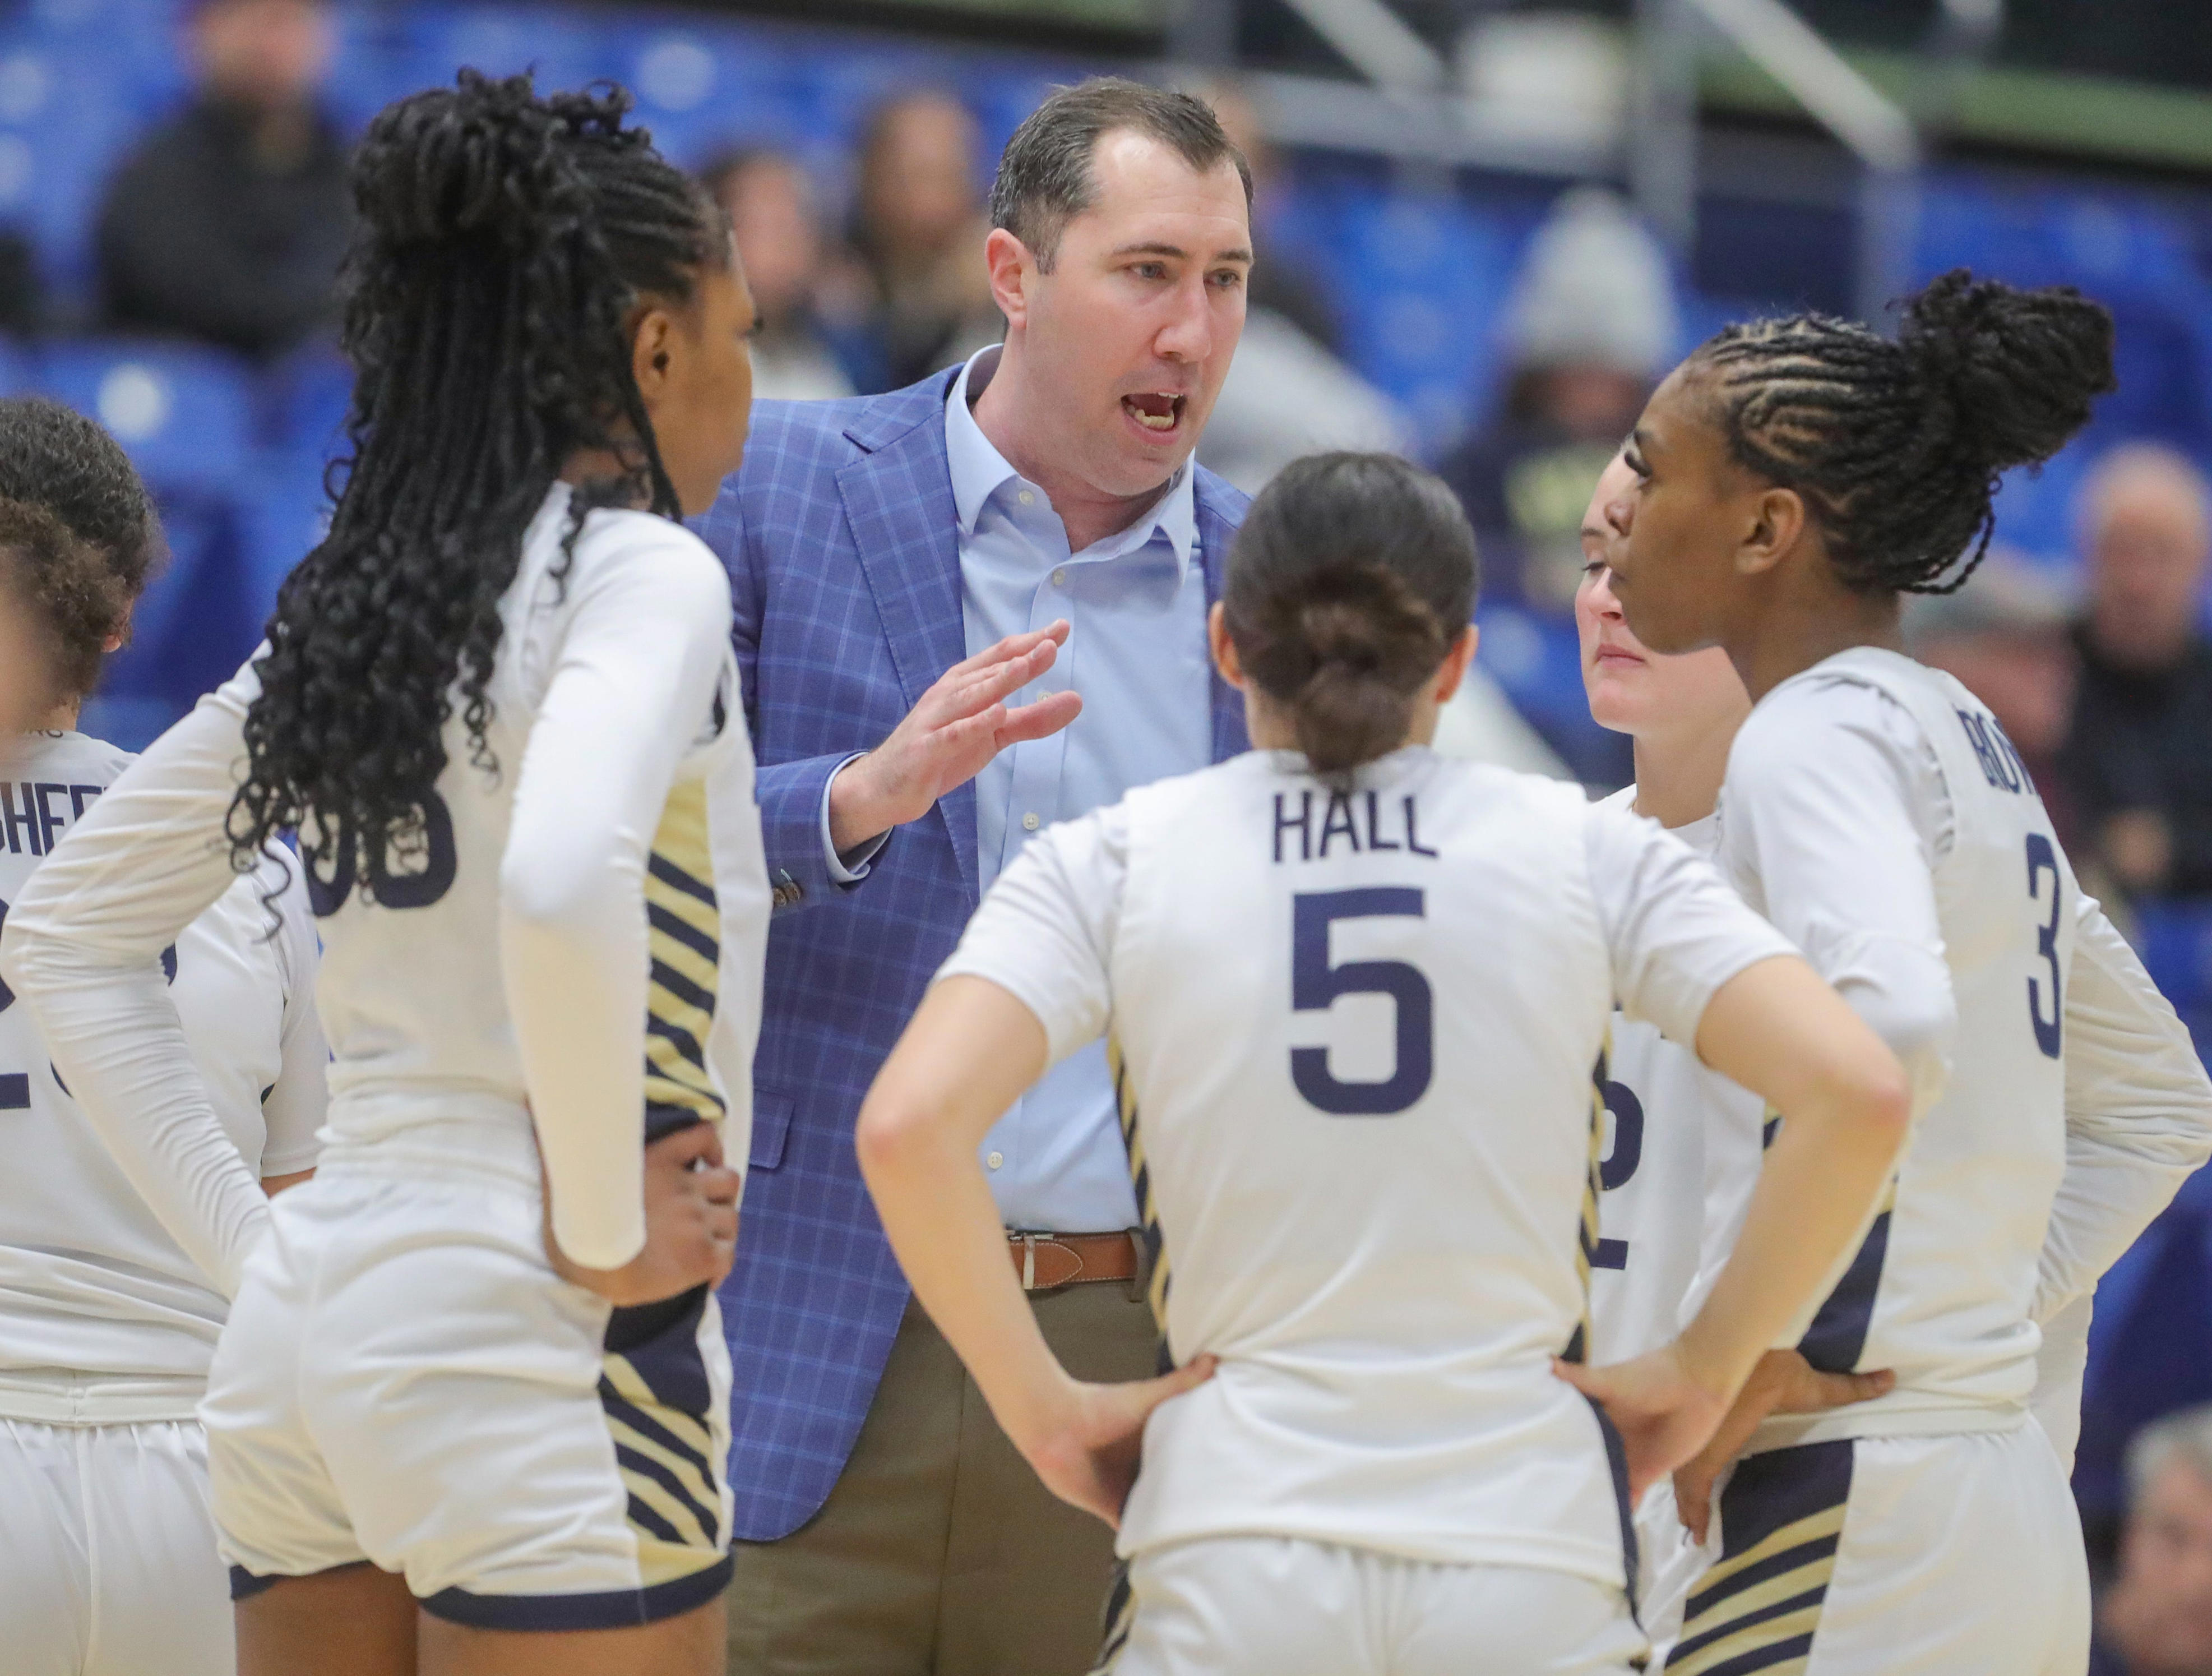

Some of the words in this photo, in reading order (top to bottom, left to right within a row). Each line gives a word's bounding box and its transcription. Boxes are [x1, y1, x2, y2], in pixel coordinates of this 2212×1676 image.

[1274, 791, 1438, 862] HALL
[1292, 887, 1432, 1115] 5
[2026, 833, 2061, 1059] 3
